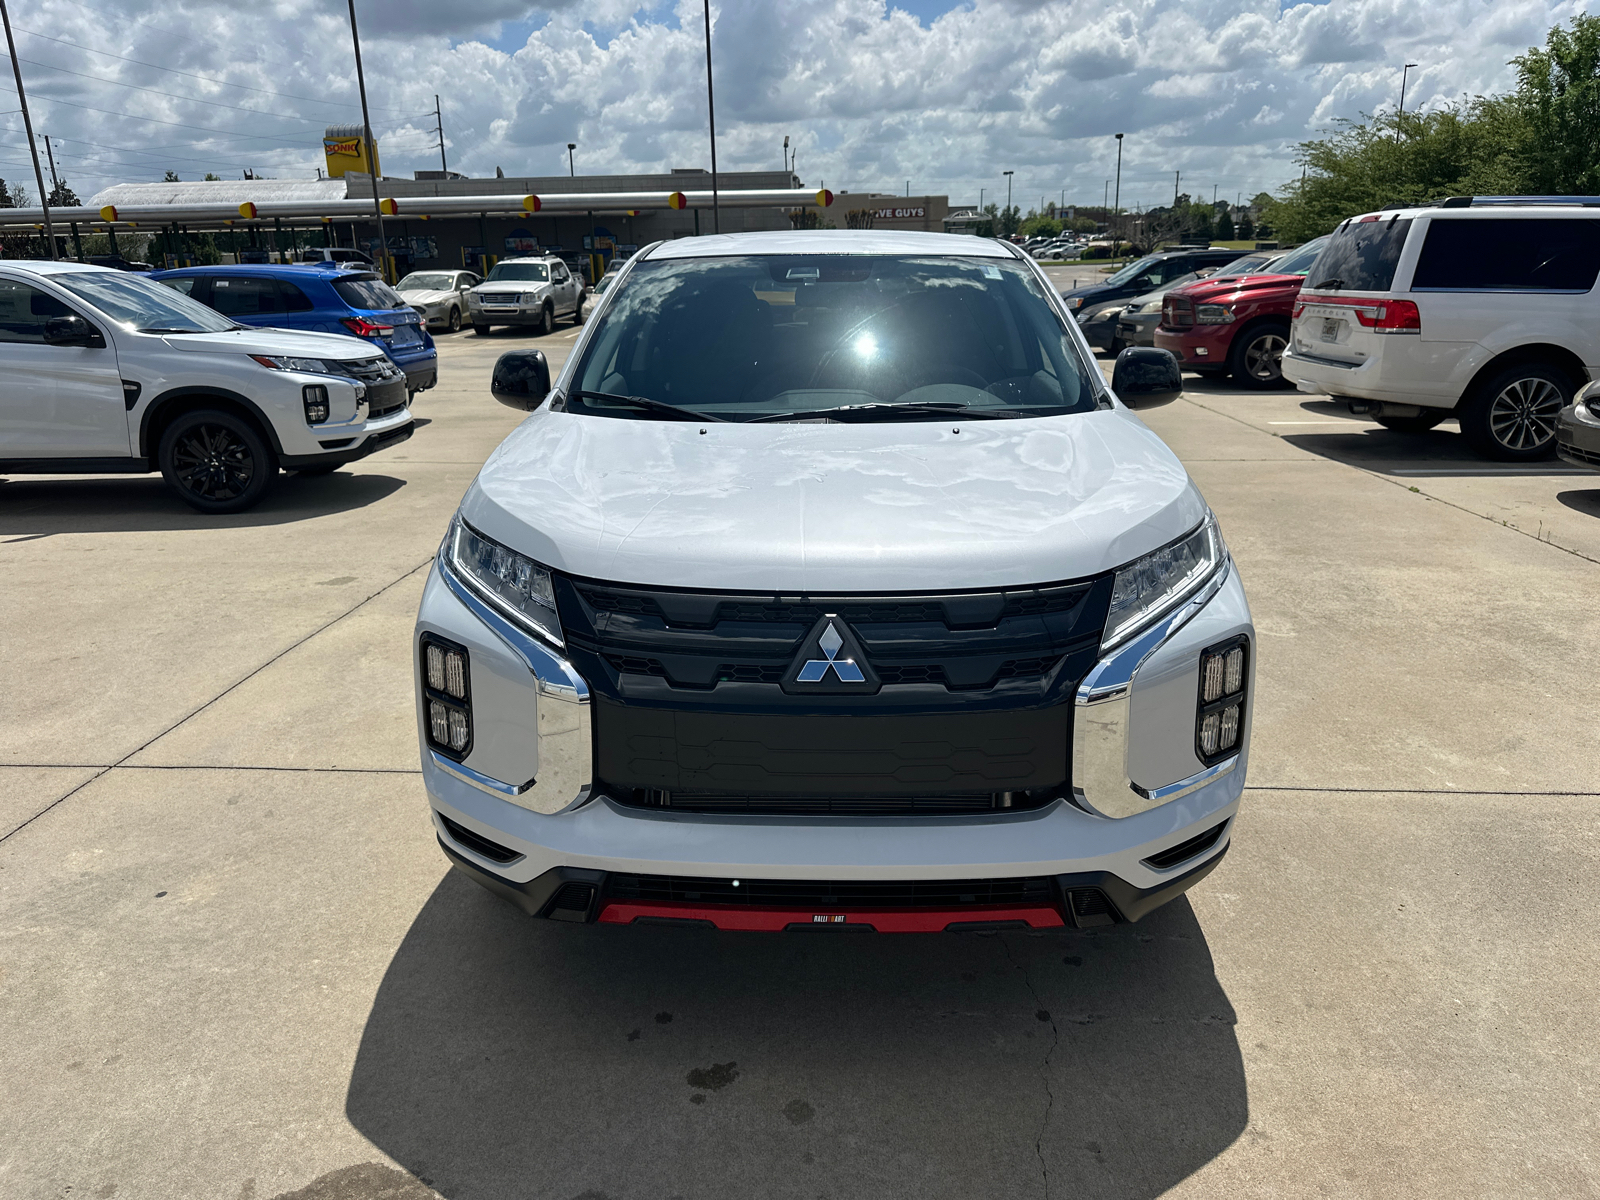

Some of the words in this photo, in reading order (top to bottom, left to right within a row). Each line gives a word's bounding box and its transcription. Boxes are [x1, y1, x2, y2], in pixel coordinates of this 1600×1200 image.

[326, 144, 357, 152] SONIC
[894, 207, 925, 217] GUYS
[1307, 308, 1347, 316] LINCOLN
